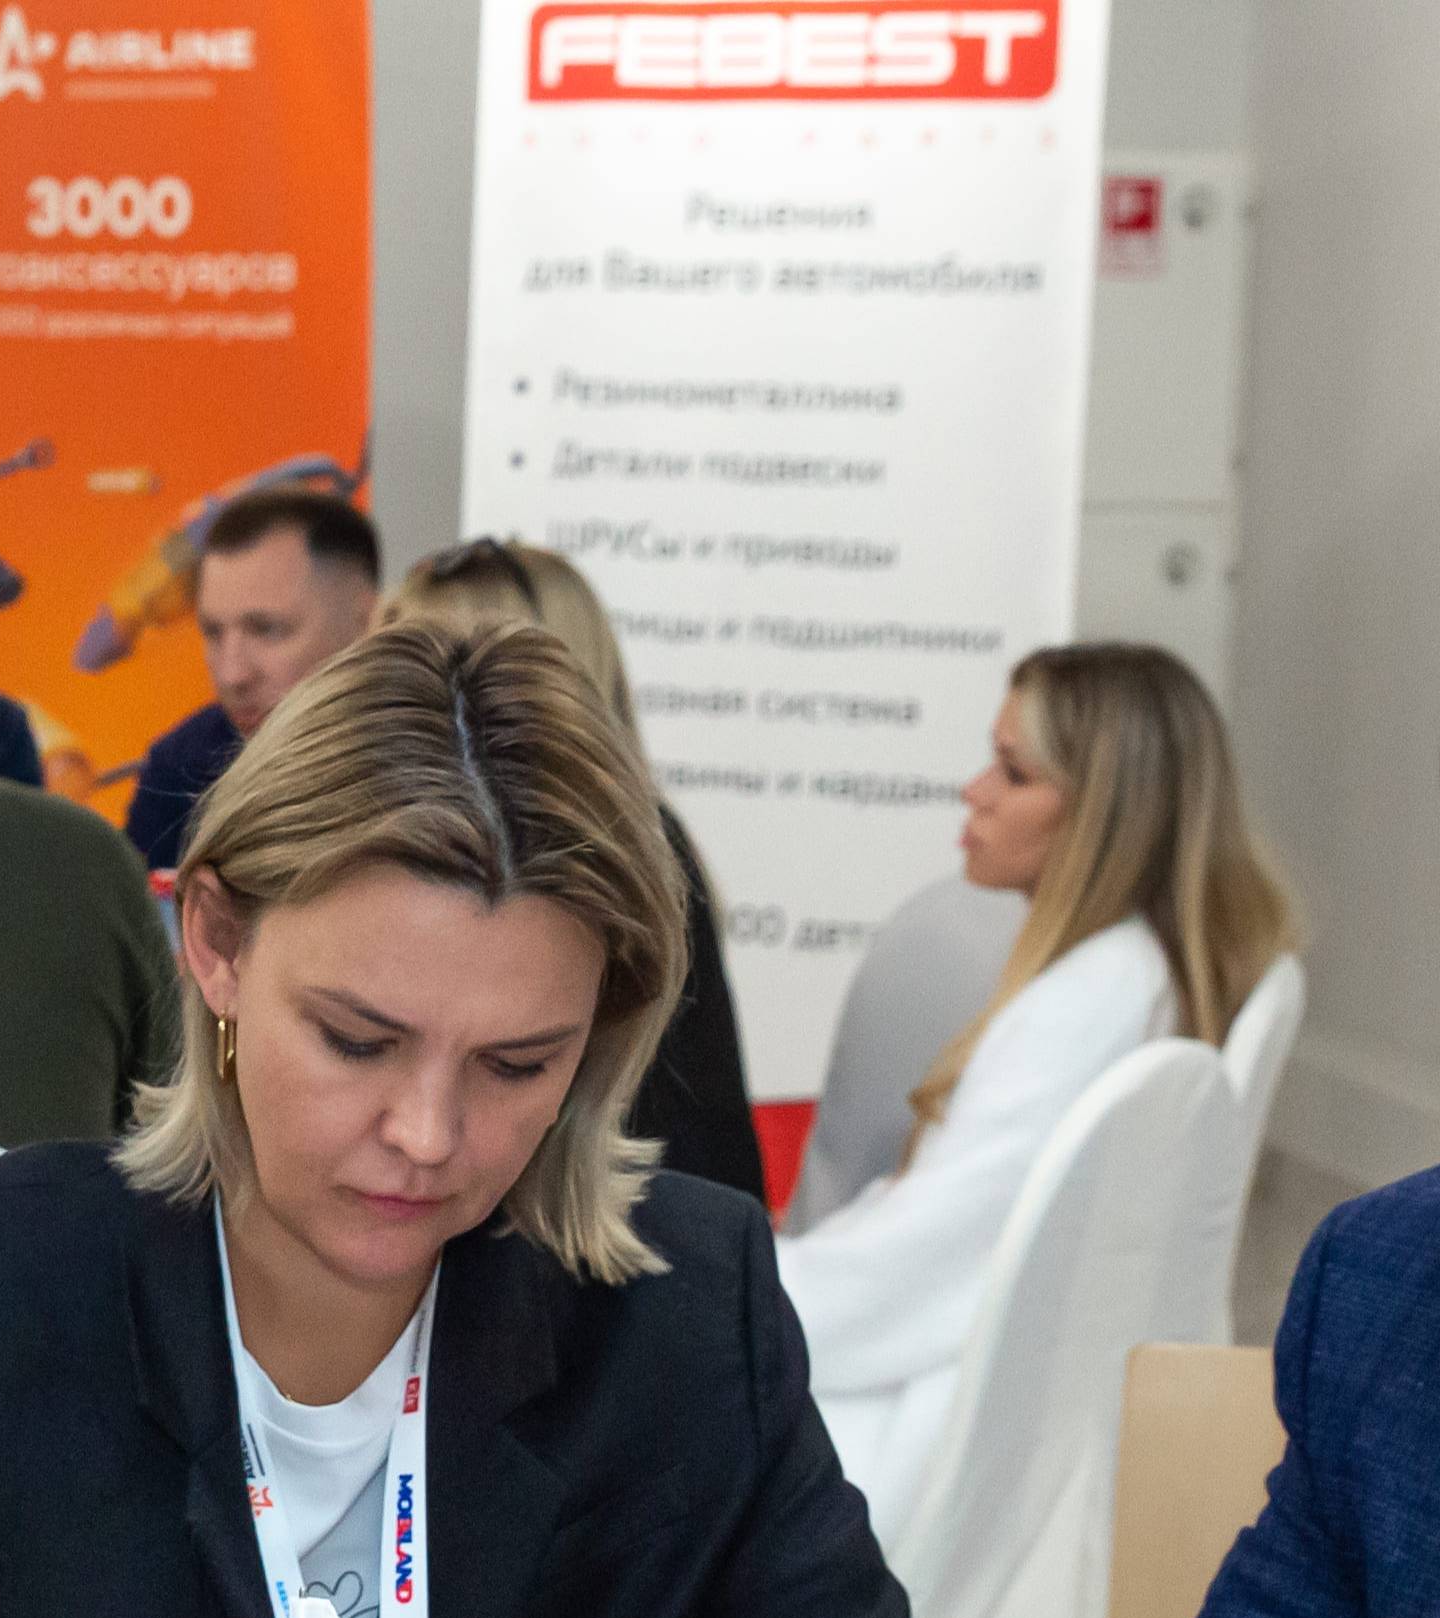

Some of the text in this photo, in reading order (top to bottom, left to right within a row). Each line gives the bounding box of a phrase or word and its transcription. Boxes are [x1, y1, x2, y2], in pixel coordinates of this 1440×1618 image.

[64, 30, 255, 70] AIRLINE
[538, 12, 1046, 88] FEBEST
[26, 176, 191, 237] 3000
[685, 194, 875, 232] Решения
[524, 248, 1046, 293] для Вашего автомобиля
[551, 438, 886, 489] Детали подвески
[728, 535, 901, 573] приводы
[757, 689, 921, 727] система
[395, 1473, 414, 1604] MOBILAND
